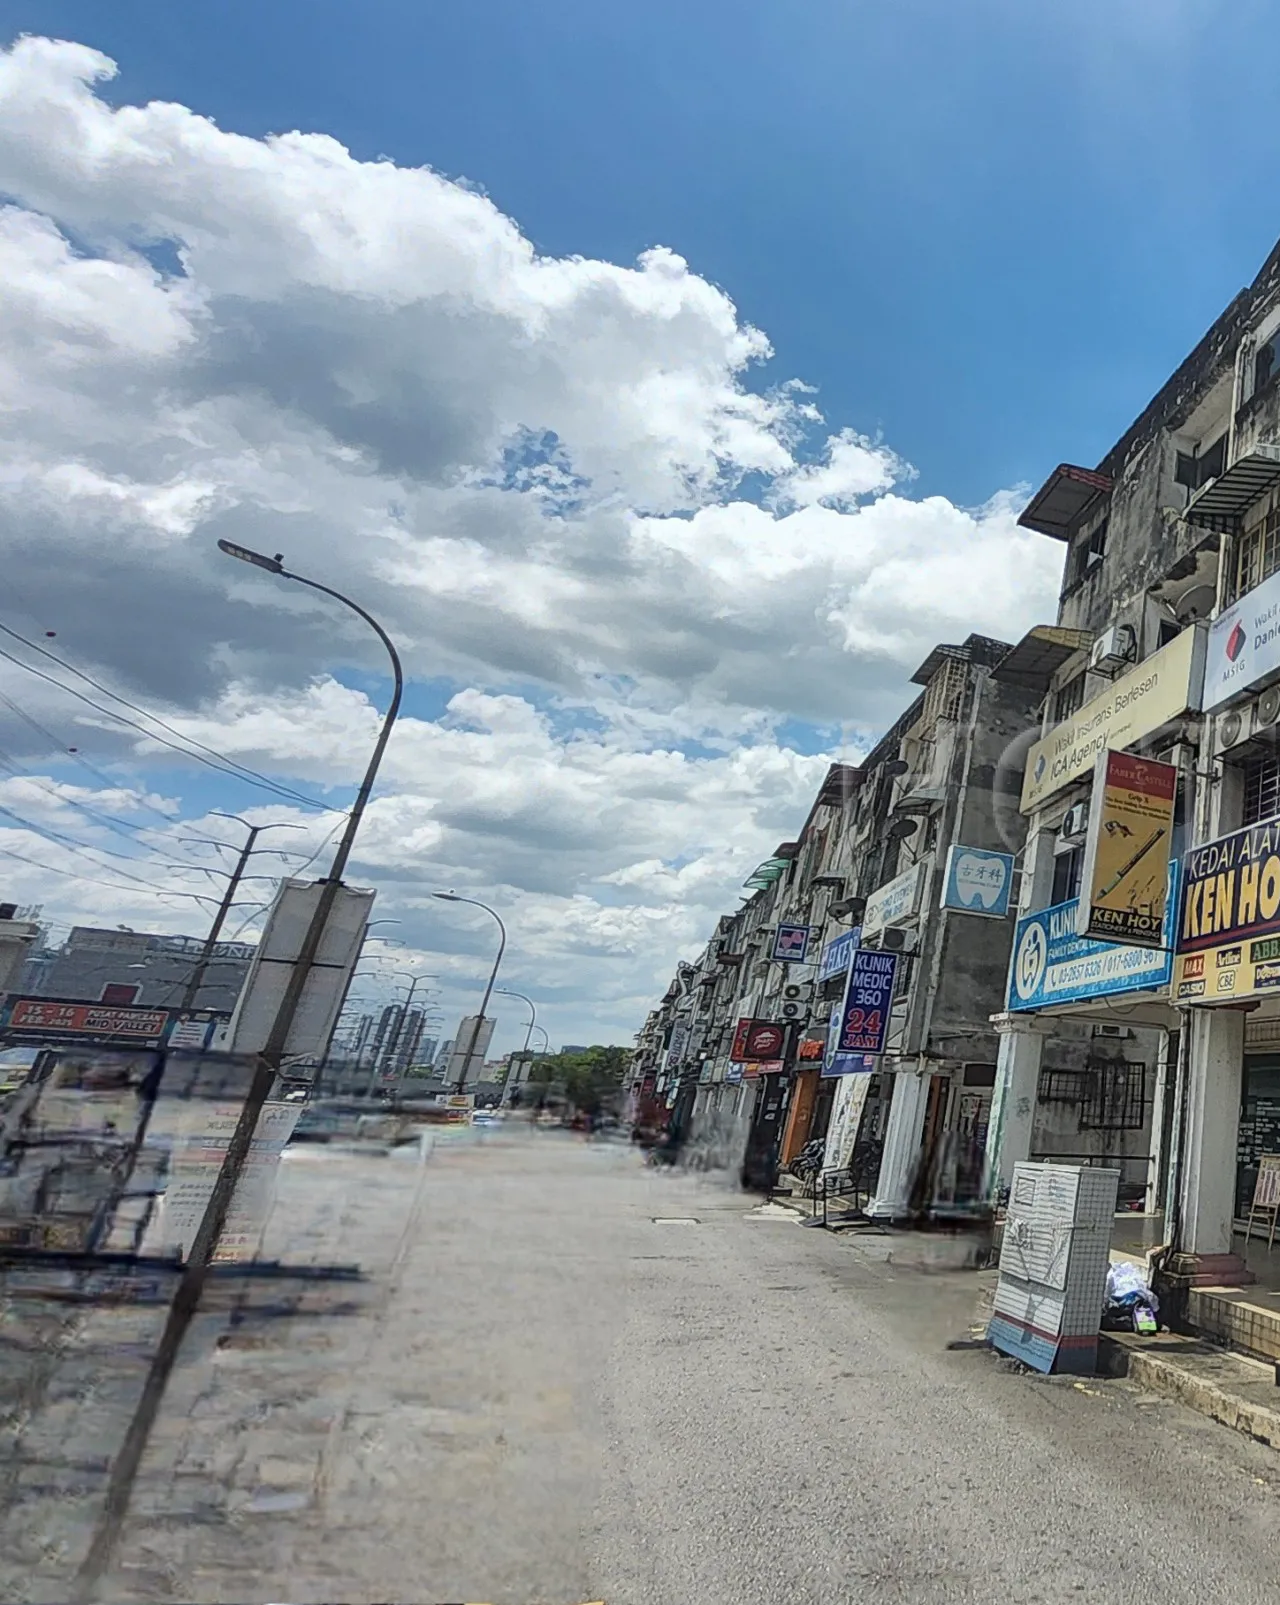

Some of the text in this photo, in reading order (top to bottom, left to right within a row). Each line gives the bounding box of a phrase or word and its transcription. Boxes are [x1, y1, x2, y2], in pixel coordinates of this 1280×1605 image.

[1253, 605, 1278, 629] Wakil
[1221, 659, 1246, 683] MSIG
[1076, 706, 1113, 741] Insurans
[1114, 671, 1159, 714] Berlesen
[1050, 754, 1068, 783] ICA
[1067, 729, 1111, 769] Agency
[1188, 838, 1236, 881] KEDAI
[1182, 869, 1236, 941] KEN
[1050, 909, 1080, 940] KLINI
[1092, 908, 1161, 931] KEN HOY
[855, 954, 894, 974] KLINIK
[1184, 957, 1204, 976] MAX
[1217, 951, 1241, 966] Artline
[852, 972, 892, 990] MEDIC
[1178, 982, 1206, 997] CASIO
[855, 988, 881, 1006] 360
[85, 1018, 157, 1032] MID VALLEY
[846, 1007, 882, 1035] 24
[843, 1034, 880, 1049] JAM
